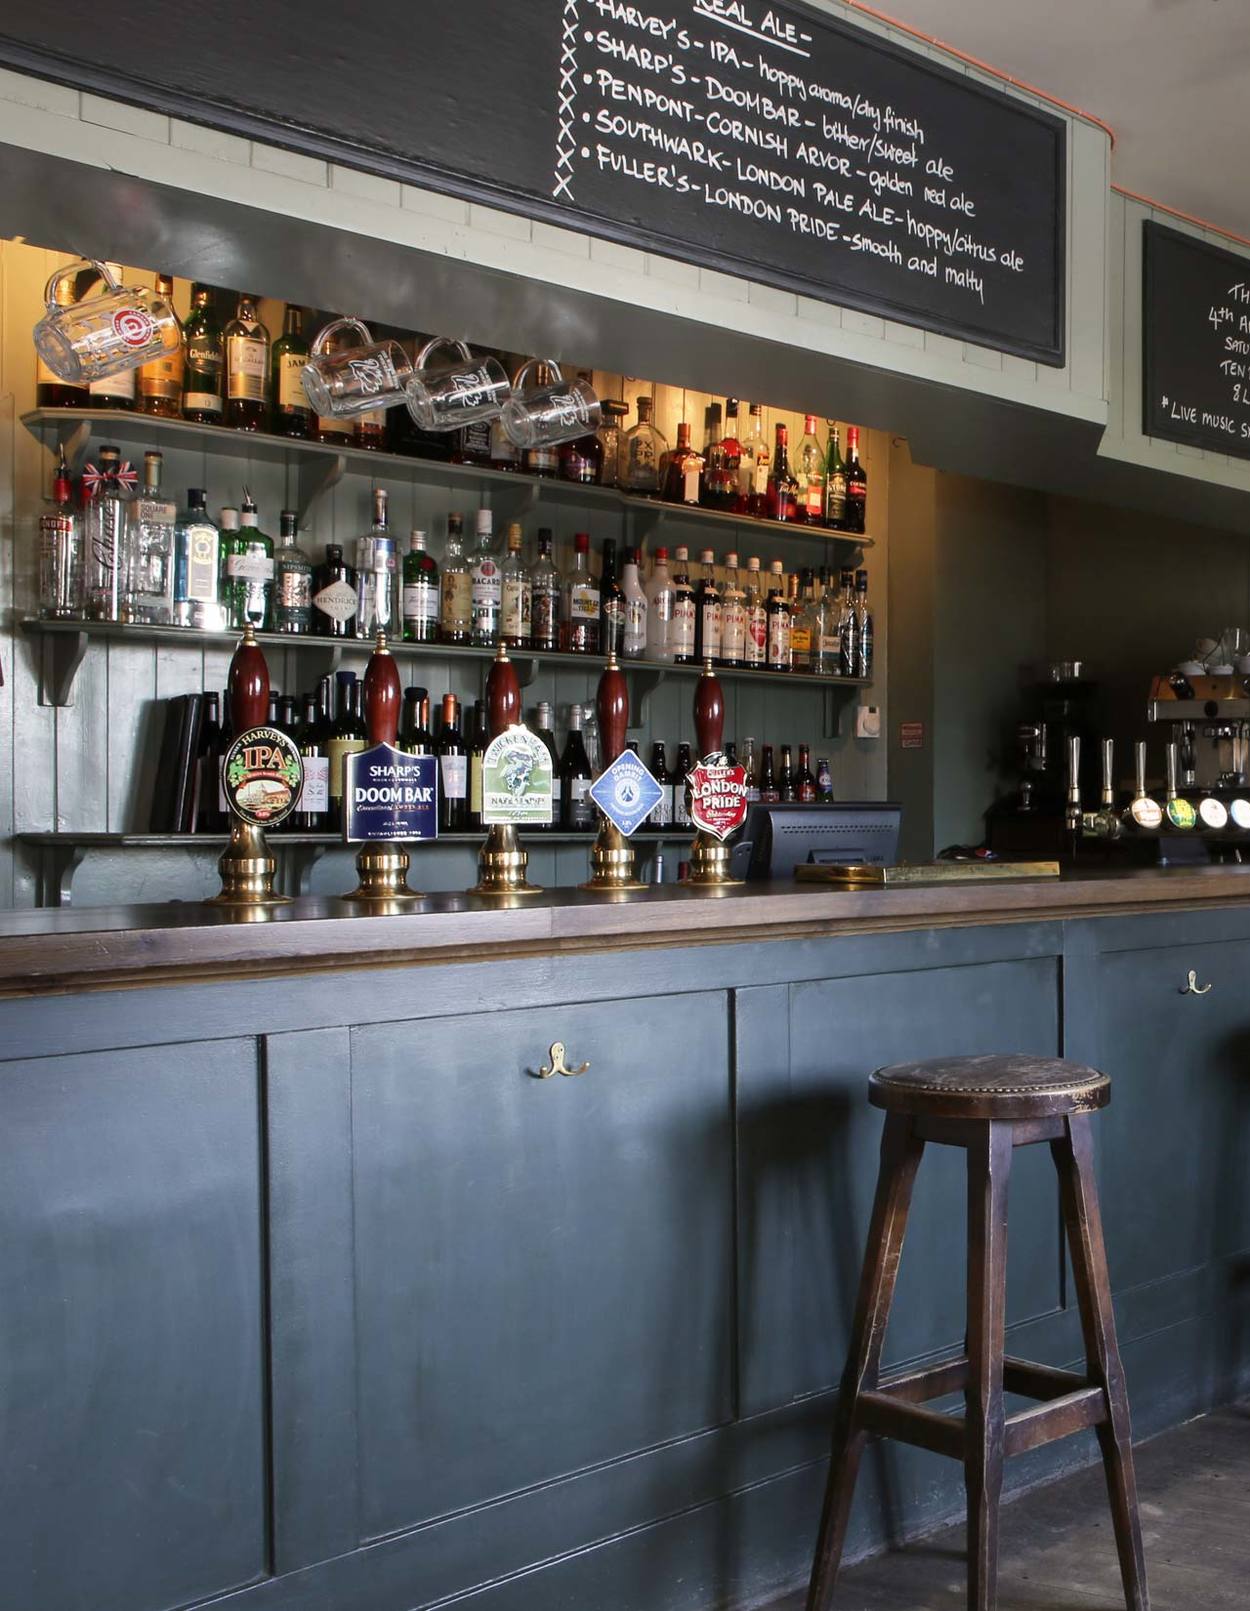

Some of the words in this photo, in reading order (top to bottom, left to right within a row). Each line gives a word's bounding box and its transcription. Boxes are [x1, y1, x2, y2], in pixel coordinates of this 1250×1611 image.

[759, 54, 806, 101] hoppy
[883, 106, 925, 144] finish
[706, 111, 788, 159] CORNISH
[869, 170, 914, 197] golden
[924, 186, 946, 209] red
[950, 191, 977, 218] ale
[925, 157, 955, 183] ale
[737, 157, 805, 198] LONDON
[812, 182, 854, 213] PALE
[1000, 250, 1024, 272] ale
[705, 184, 781, 224] LONDON
[787, 208, 840, 241] PRIDE
[908, 256, 937, 277] and
[945, 266, 984, 305] malty
[1208, 306, 1234, 331] 4th
[1220, 360, 1246, 378] TEN
[1202, 412, 1236, 434] MUSIC
[242, 745, 288, 770] IPA
[369, 765, 421, 777] SHARP'S
[355, 787, 402, 803] DOOM
[404, 787, 433, 803] BAR
[692, 780, 749, 800] LONDON
[702, 796, 741, 809] PRIDE
